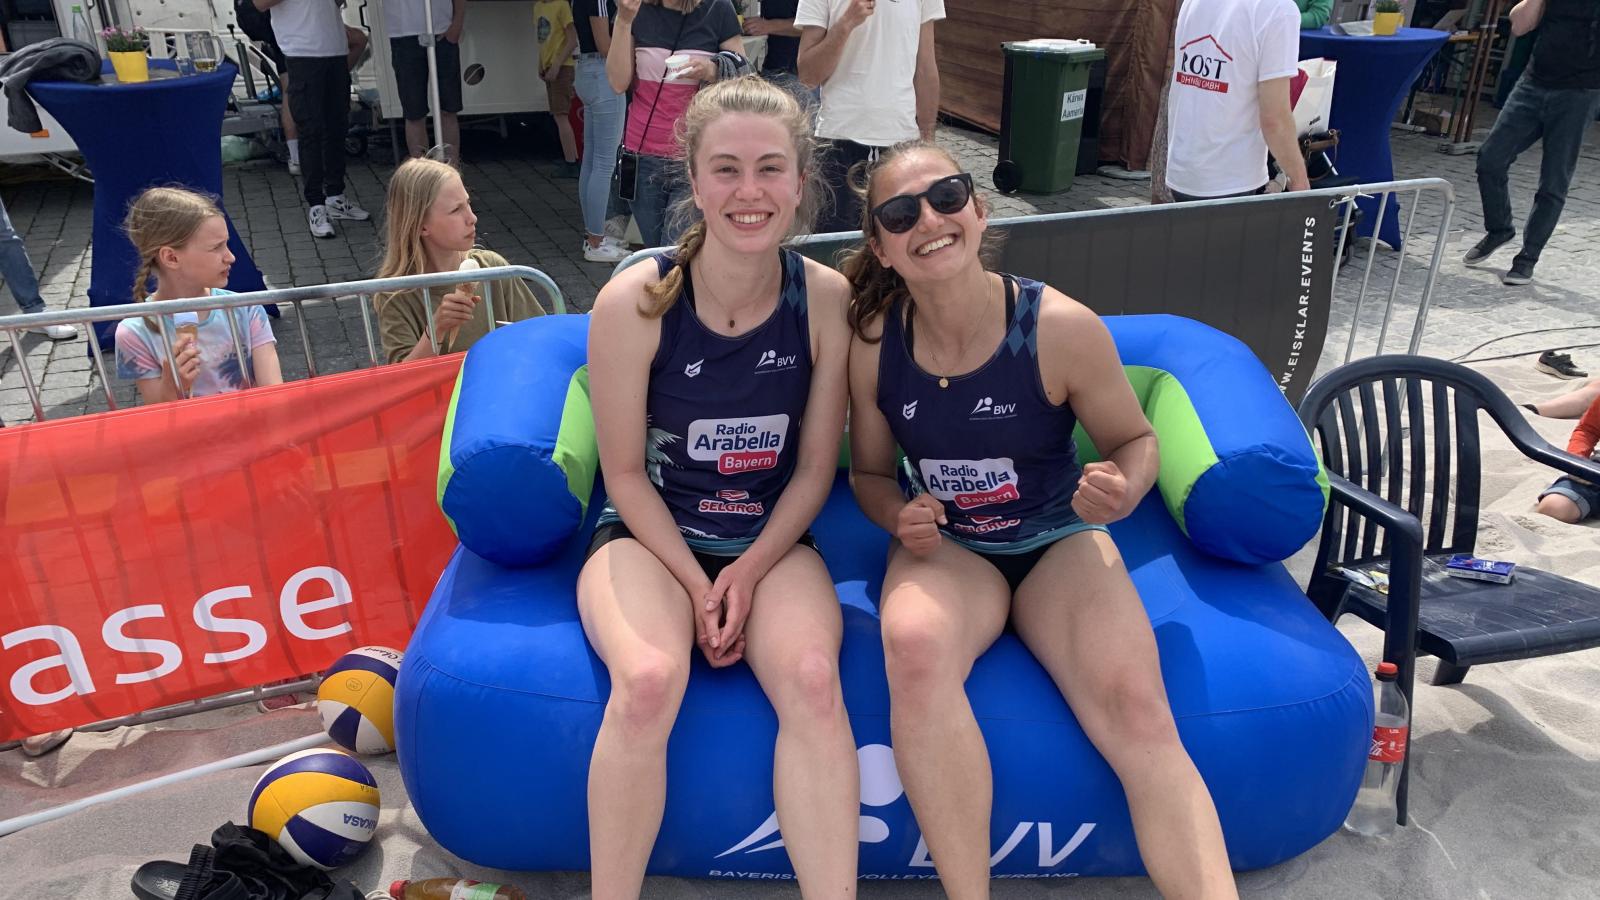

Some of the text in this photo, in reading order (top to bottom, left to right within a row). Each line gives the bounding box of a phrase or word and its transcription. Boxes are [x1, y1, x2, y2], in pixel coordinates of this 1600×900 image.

[1279, 216, 1316, 395] W.EISKLAR.EVENTS
[777, 354, 797, 368] BVV
[993, 403, 1017, 415] BVV
[715, 422, 757, 436] Radio
[694, 431, 781, 451] Arabella
[724, 455, 772, 470] Bayern
[940, 464, 979, 477] Radio
[929, 470, 1011, 492] Arabella
[960, 490, 1013, 504] Bayern
[699, 500, 764, 516] SELGROS
[0, 565, 353, 707] asse
